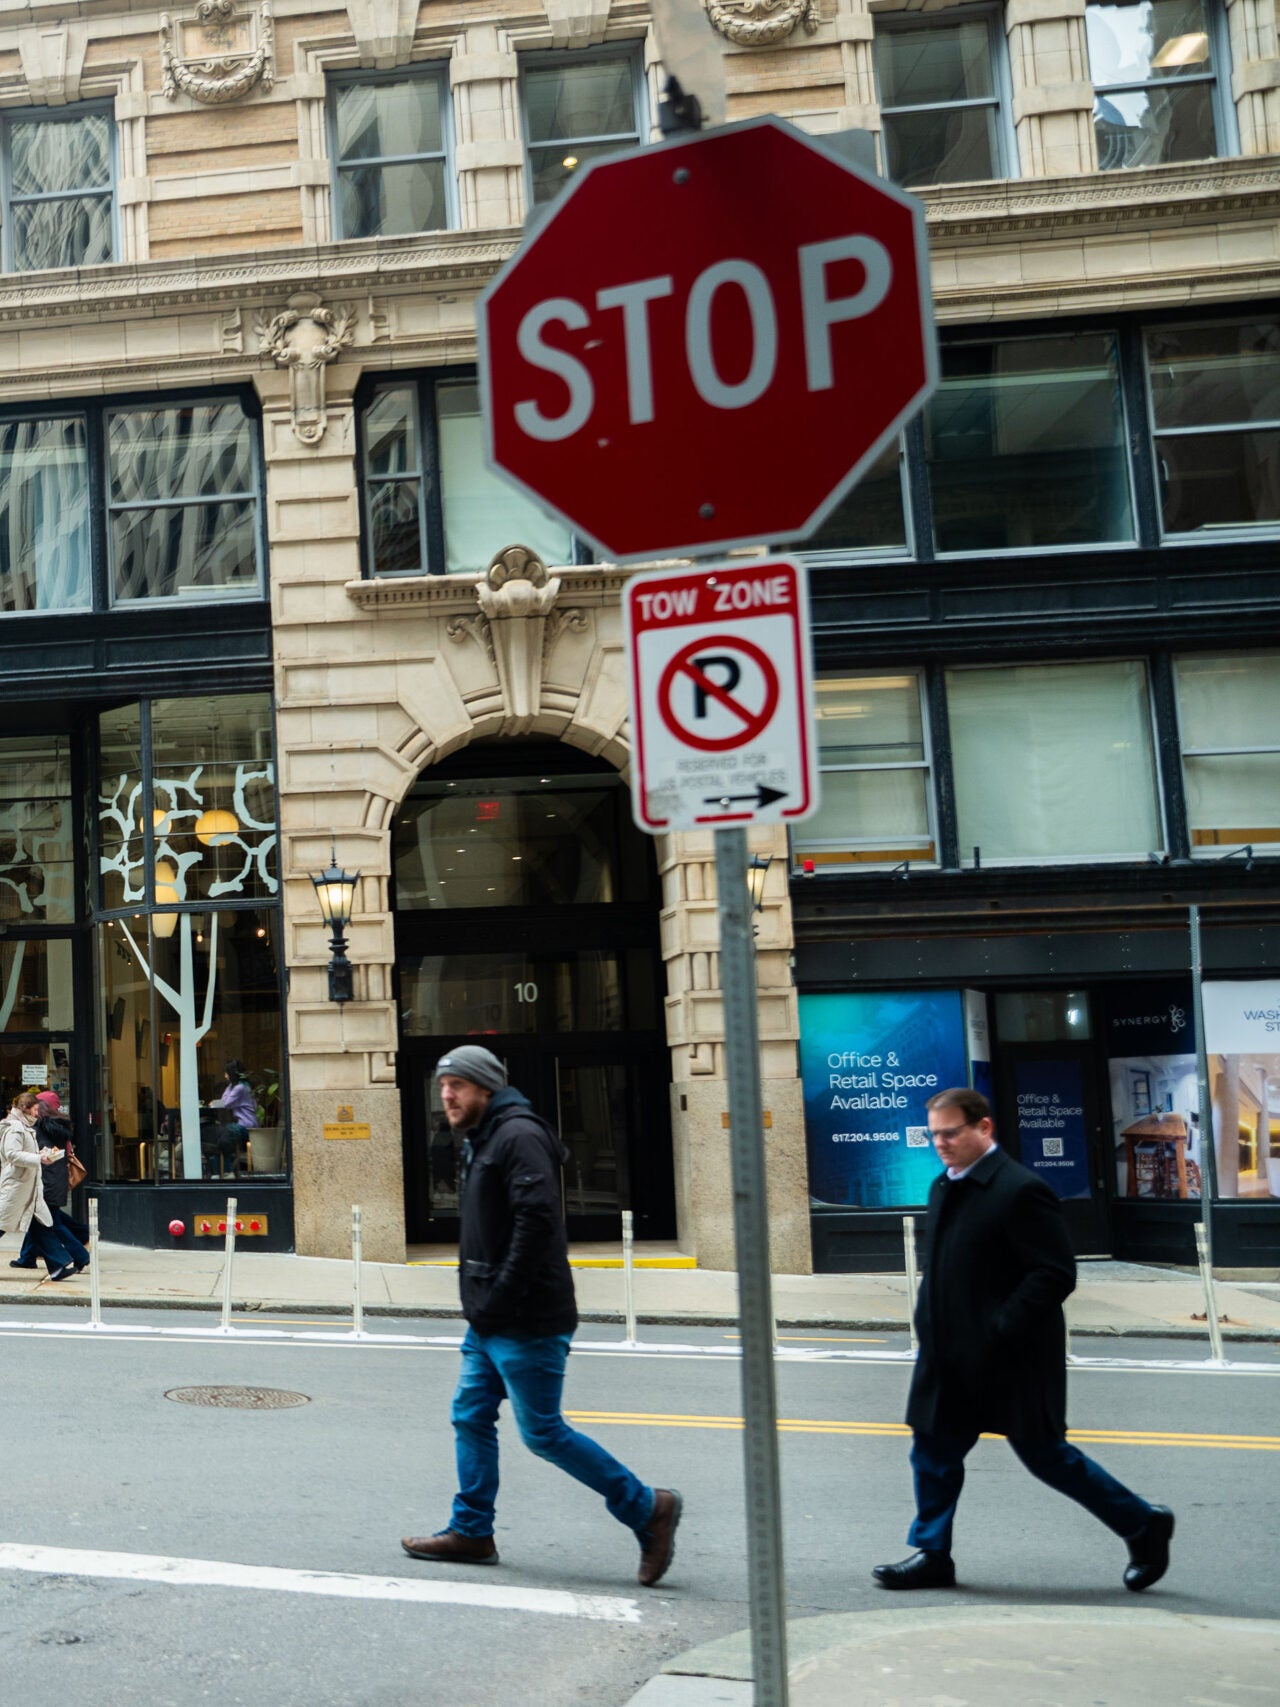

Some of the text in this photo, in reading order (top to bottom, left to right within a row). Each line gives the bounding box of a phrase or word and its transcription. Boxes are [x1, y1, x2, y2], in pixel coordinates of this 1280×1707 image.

[513, 234, 893, 442] STOP
[636, 575, 791, 621] TOW ZONE
[514, 982, 538, 1002] 10
[1112, 1015, 1167, 1027] SYNERGY
[827, 1051, 900, 1068] Office &
[829, 1072, 938, 1091] Retail Space
[830, 1092, 908, 1110] Available
[1016, 1093, 1050, 1104] Office
[1018, 1106, 1083, 1117] Retail Space
[1019, 1118, 1065, 1128] Available
[832, 1132, 900, 1142] 617.204.9506
